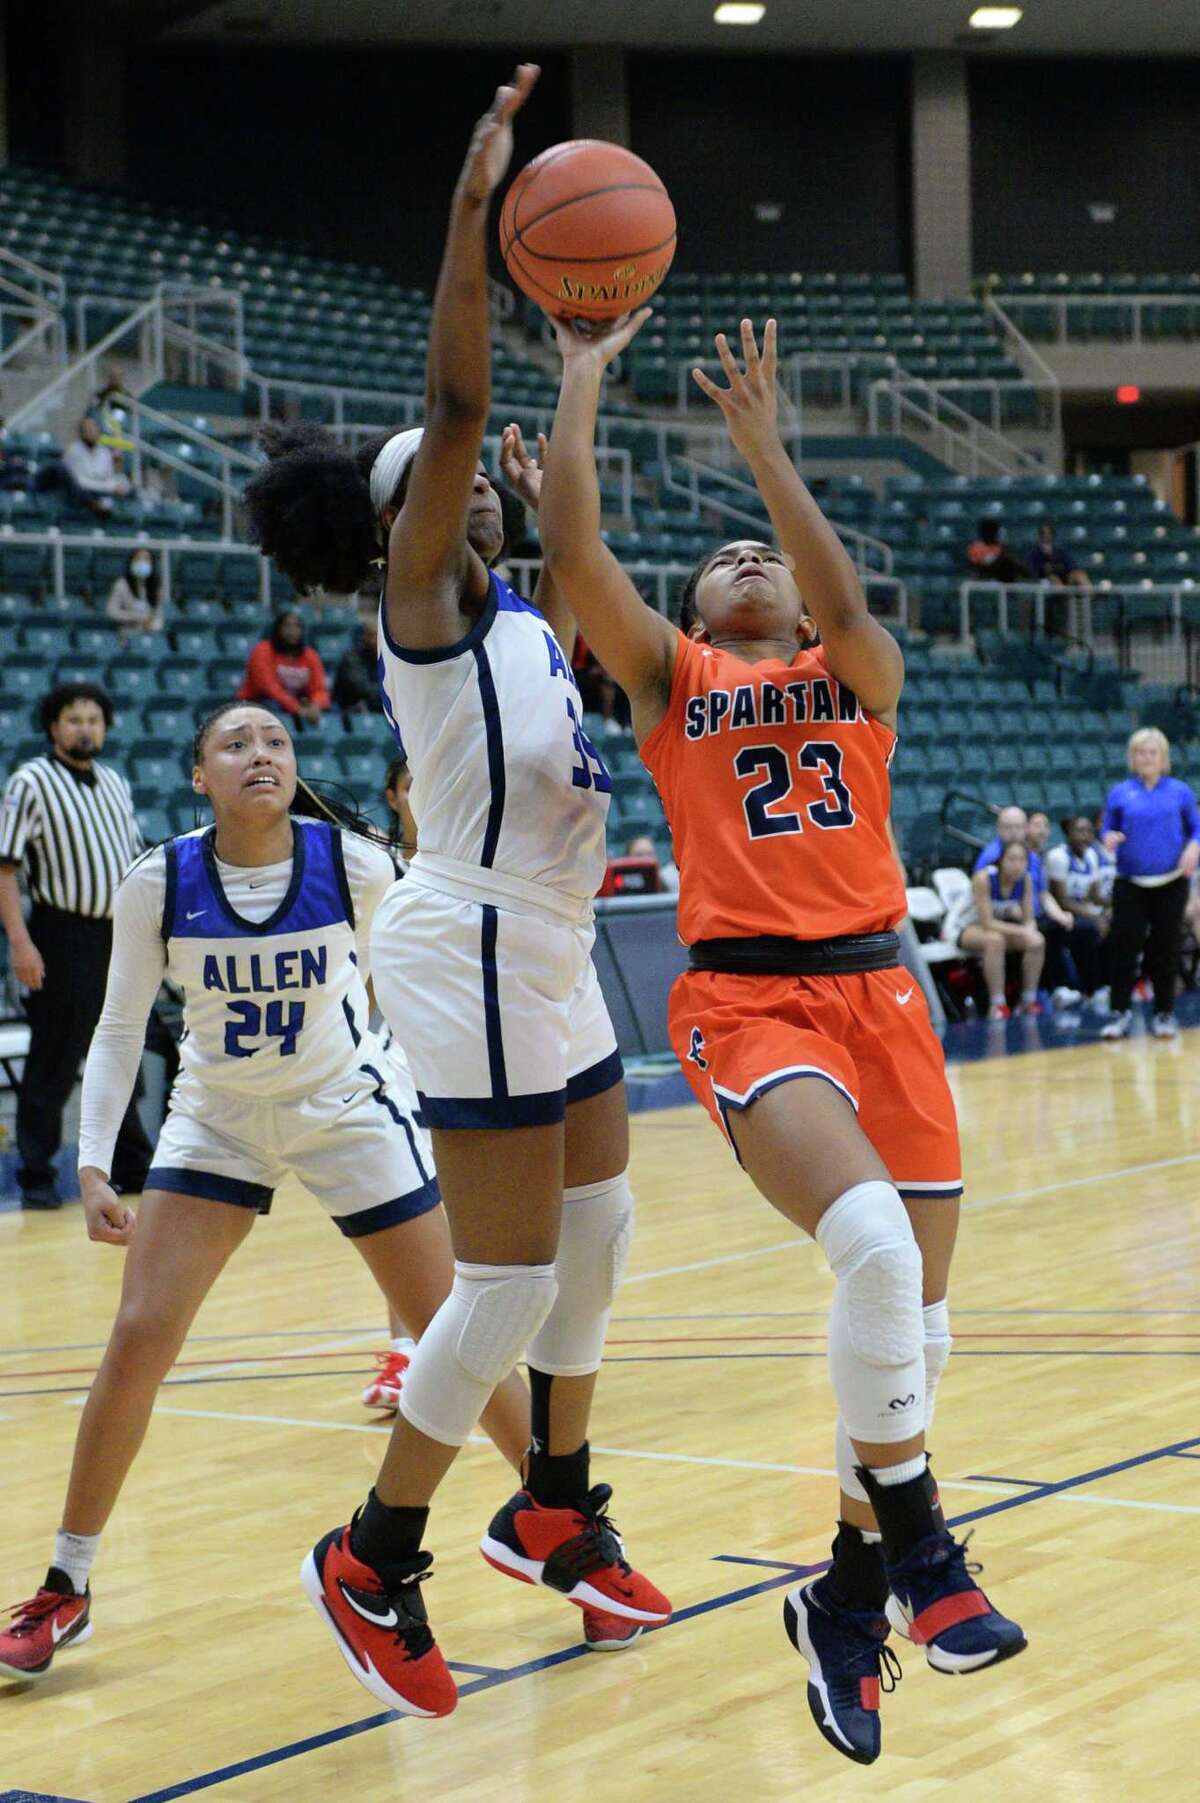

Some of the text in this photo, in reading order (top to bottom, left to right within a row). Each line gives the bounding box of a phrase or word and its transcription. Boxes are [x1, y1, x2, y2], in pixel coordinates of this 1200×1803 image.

[685, 678, 869, 741] SPARTAN
[733, 740, 857, 841] 23
[203, 945, 327, 993] ALLEN
[224, 1000, 306, 1058] 24
